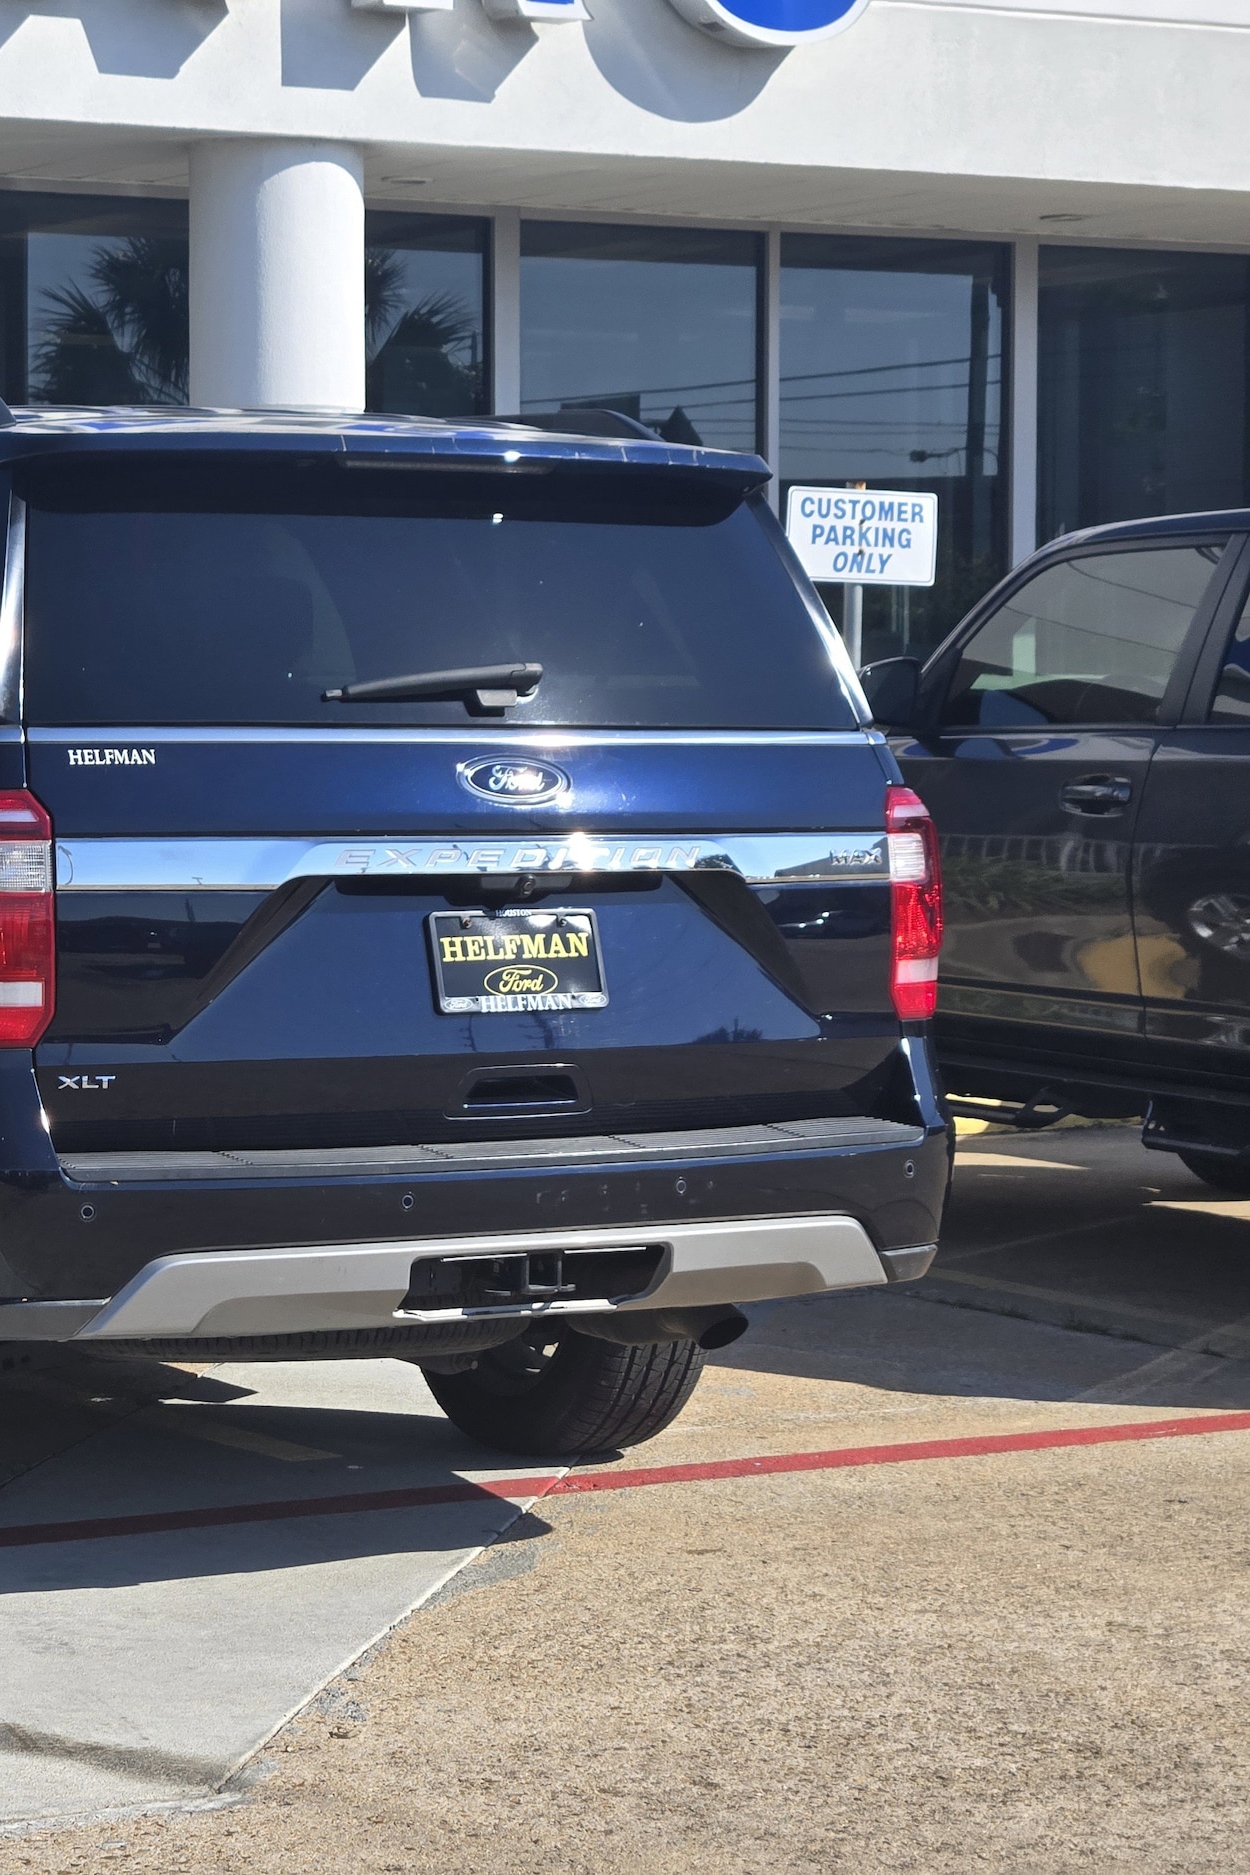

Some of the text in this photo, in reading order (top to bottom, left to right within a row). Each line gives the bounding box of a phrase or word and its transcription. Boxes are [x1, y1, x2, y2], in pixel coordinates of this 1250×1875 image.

[800, 497, 924, 523] CUSTOMER
[811, 524, 912, 548] PARKING
[832, 551, 893, 574] ONLY
[68, 749, 156, 765] HELFMAN
[489, 765, 545, 790] Fod
[335, 846, 701, 870] EXPEDITION
[440, 932, 589, 962] HELFMAN
[499, 968, 544, 993] Ford
[480, 993, 573, 1013] HELFMAN
[58, 1075, 116, 1089] XLT
